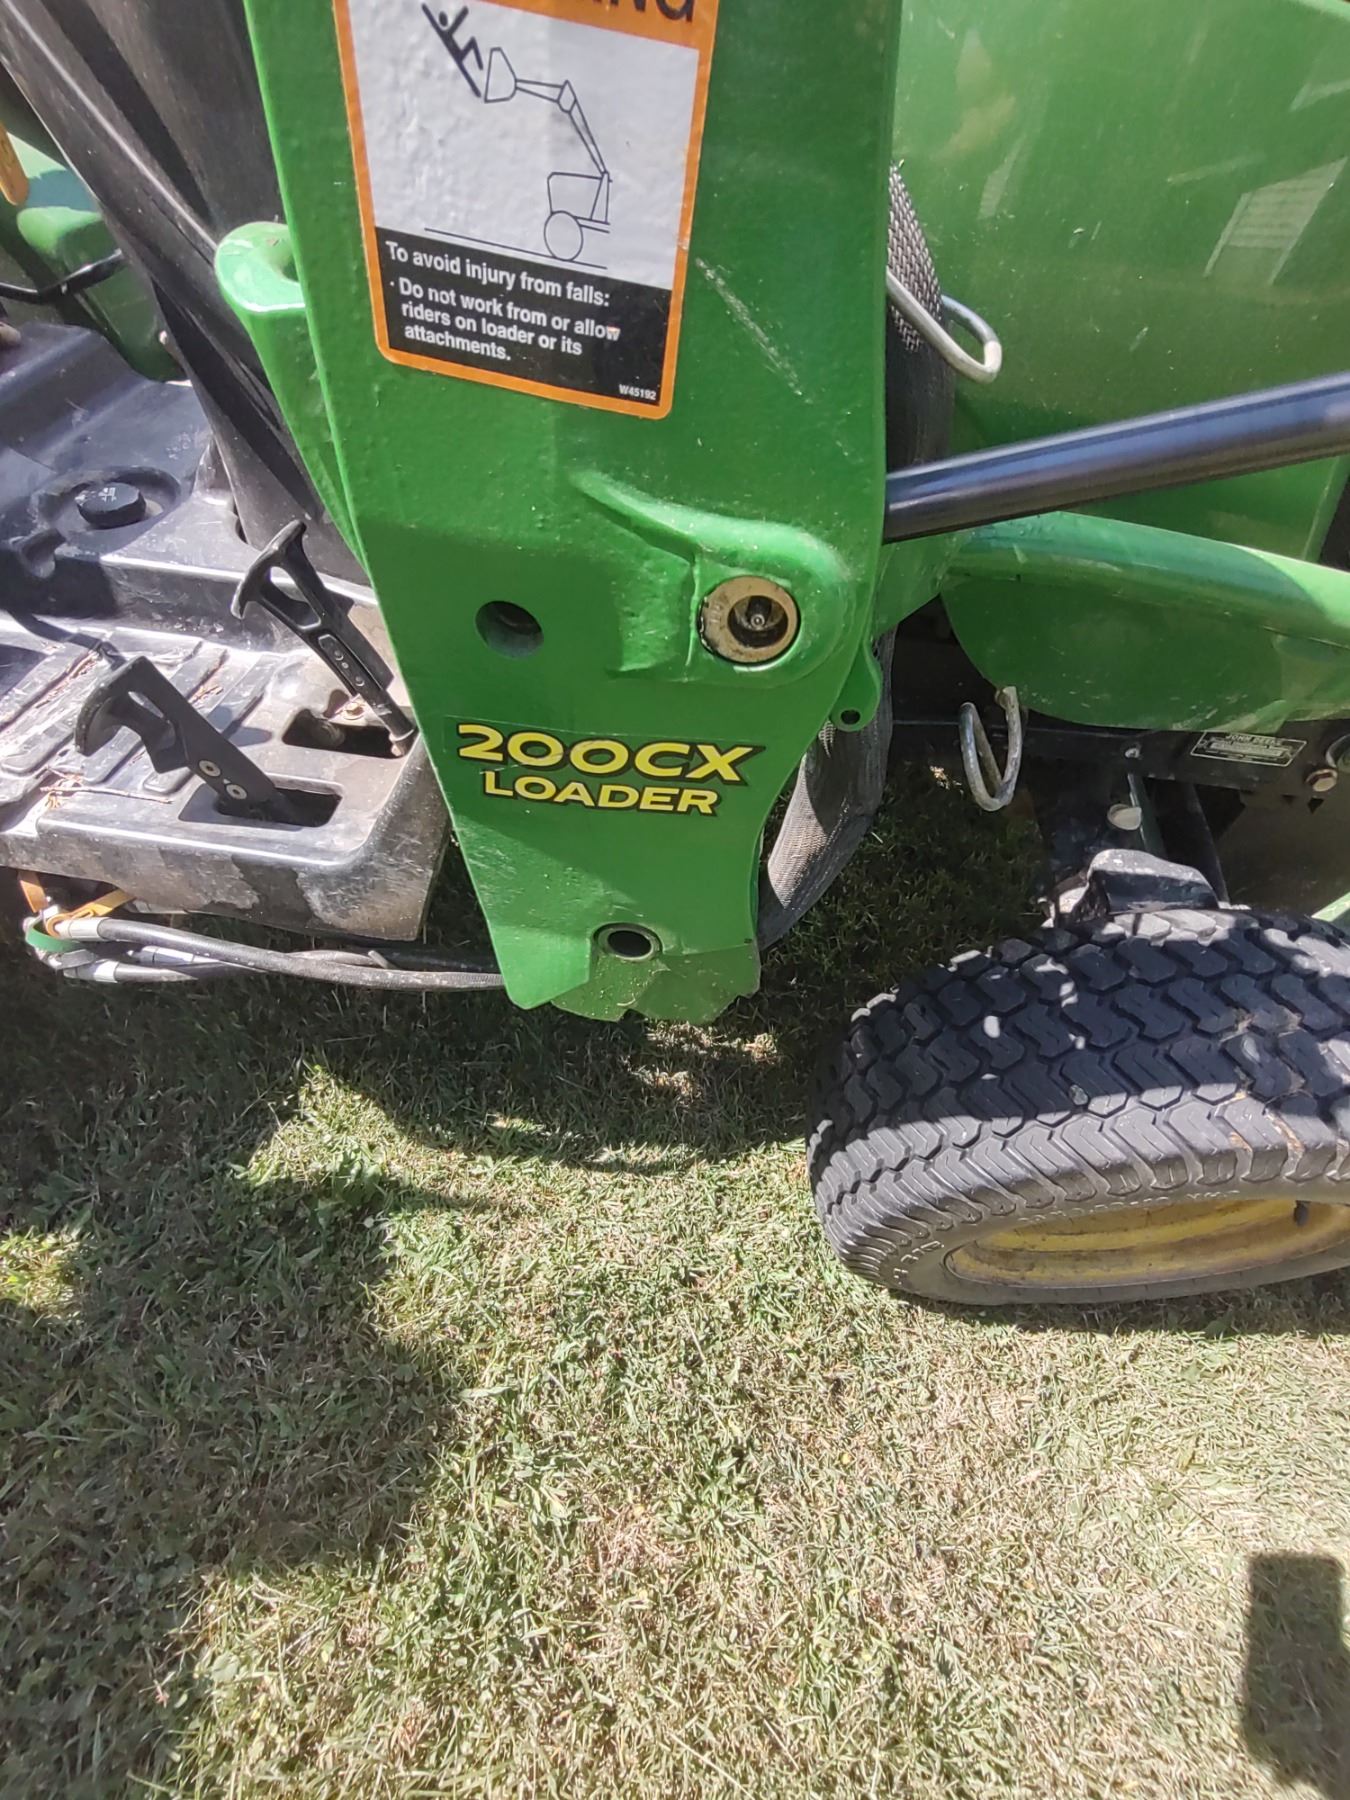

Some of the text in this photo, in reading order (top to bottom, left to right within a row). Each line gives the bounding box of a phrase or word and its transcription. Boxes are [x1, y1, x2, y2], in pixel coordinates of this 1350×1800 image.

[385, 240, 610, 307] To avoid injury from falls:
[399, 277, 621, 341] Do not work from or allow
[401, 301, 582, 356] riders on loader or its
[404, 324, 511, 361] attachments.
[618, 383, 657, 401] W45192
[456, 722, 756, 784] 200CX
[482, 769, 720, 816] LOADER
